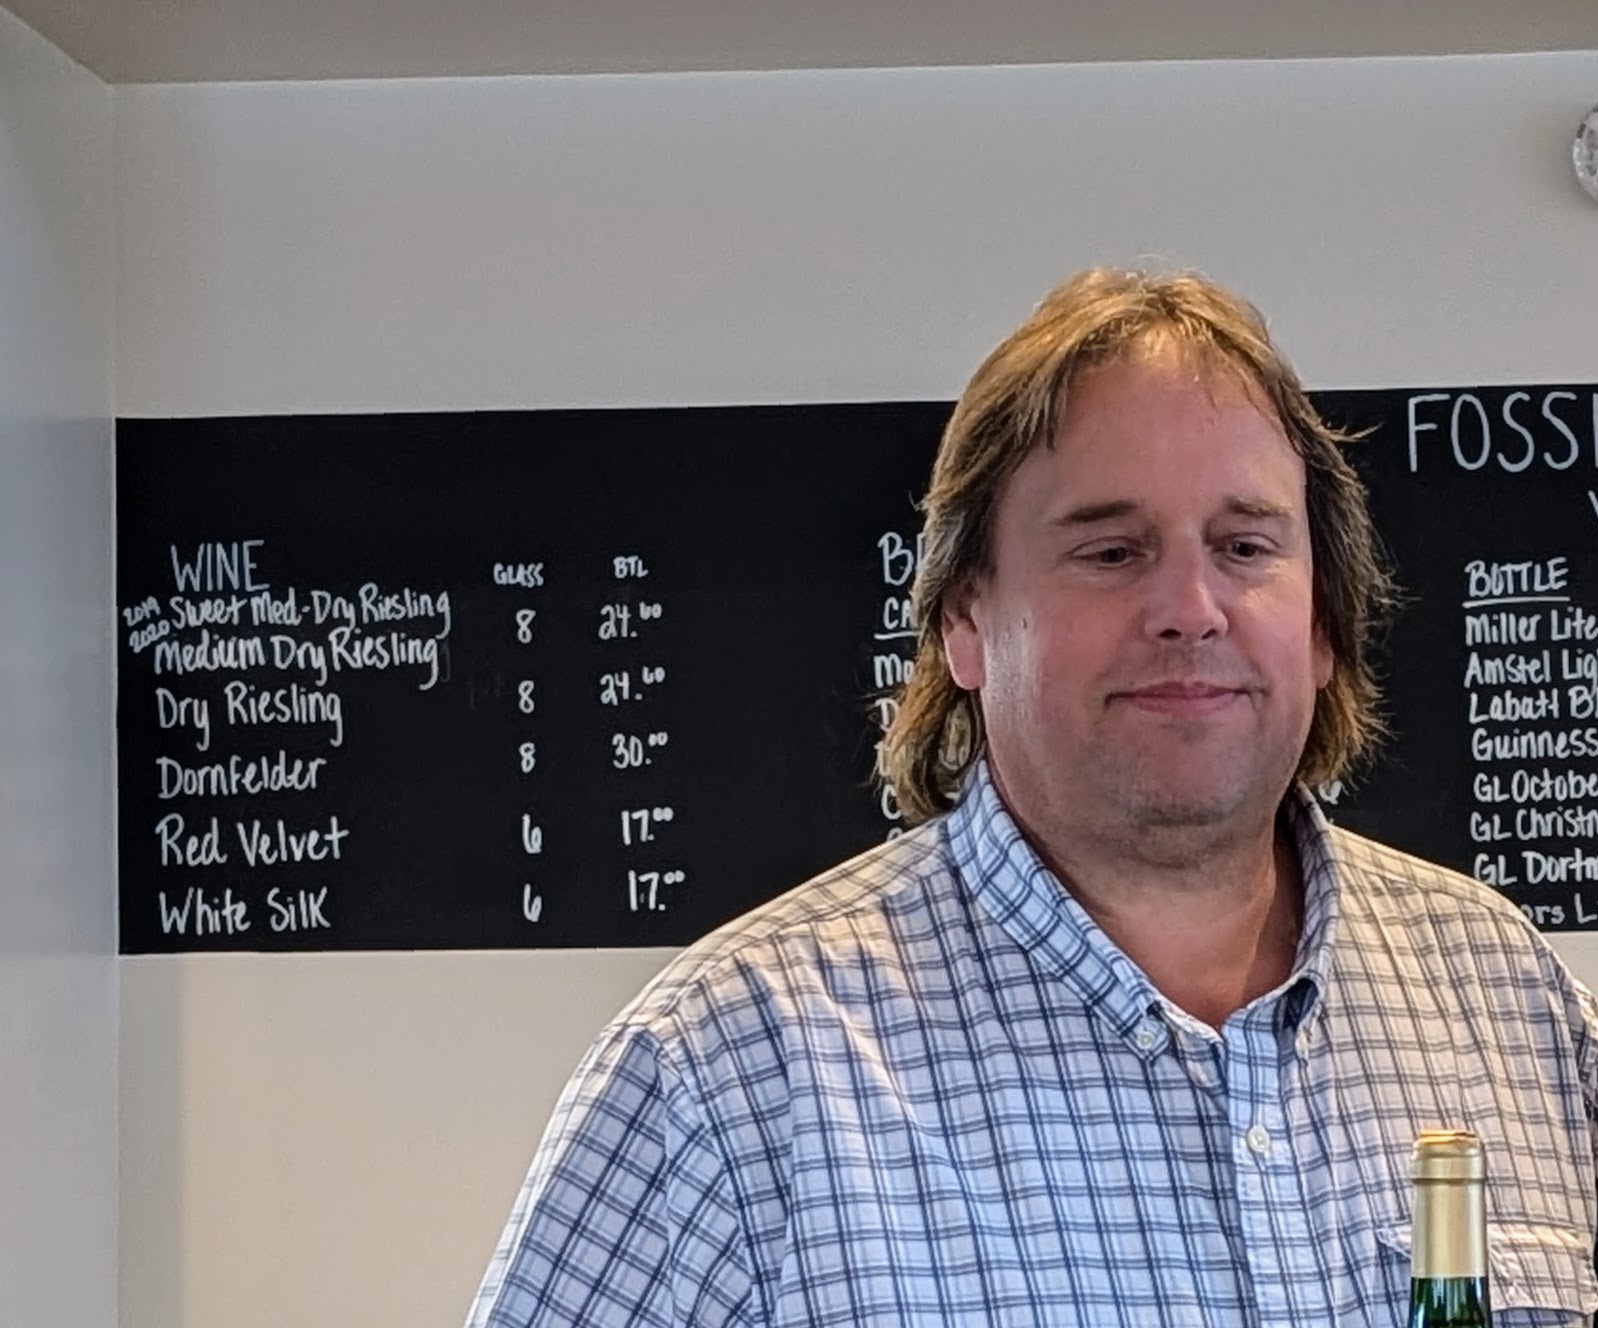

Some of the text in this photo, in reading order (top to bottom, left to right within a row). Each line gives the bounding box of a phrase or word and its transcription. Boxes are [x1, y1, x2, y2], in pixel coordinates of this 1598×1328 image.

[171, 540, 270, 592] WINE
[493, 555, 648, 588] GLASS BTL
[1464, 556, 1569, 597] BOTTLE
[170, 594, 248, 630] Sweet
[358, 582, 452, 639] Riesling
[516, 609, 536, 643] 8
[1464, 611, 1541, 646] Miller
[129, 619, 171, 653] 2020
[154, 629, 266, 675] Medium
[270, 634, 328, 687] Dry
[329, 626, 439, 690] Riesling
[518, 680, 535, 714] 8
[1463, 650, 1551, 688] Amstel
[1469, 687, 1560, 725] Labatt
[155, 687, 210, 752] Dry
[224, 680, 343, 747] Riesling
[519, 741, 535, 773] 8
[155, 749, 328, 799] Dornfelder
[155, 812, 228, 867] Red
[236, 815, 350, 868] Velvet
[522, 813, 542, 854] 6
[1469, 811, 1512, 842] GL
[1474, 852, 1518, 887] GL
[158, 886, 251, 936] White
[522, 884, 542, 922] 6
[1520, 903, 1566, 925] ors
